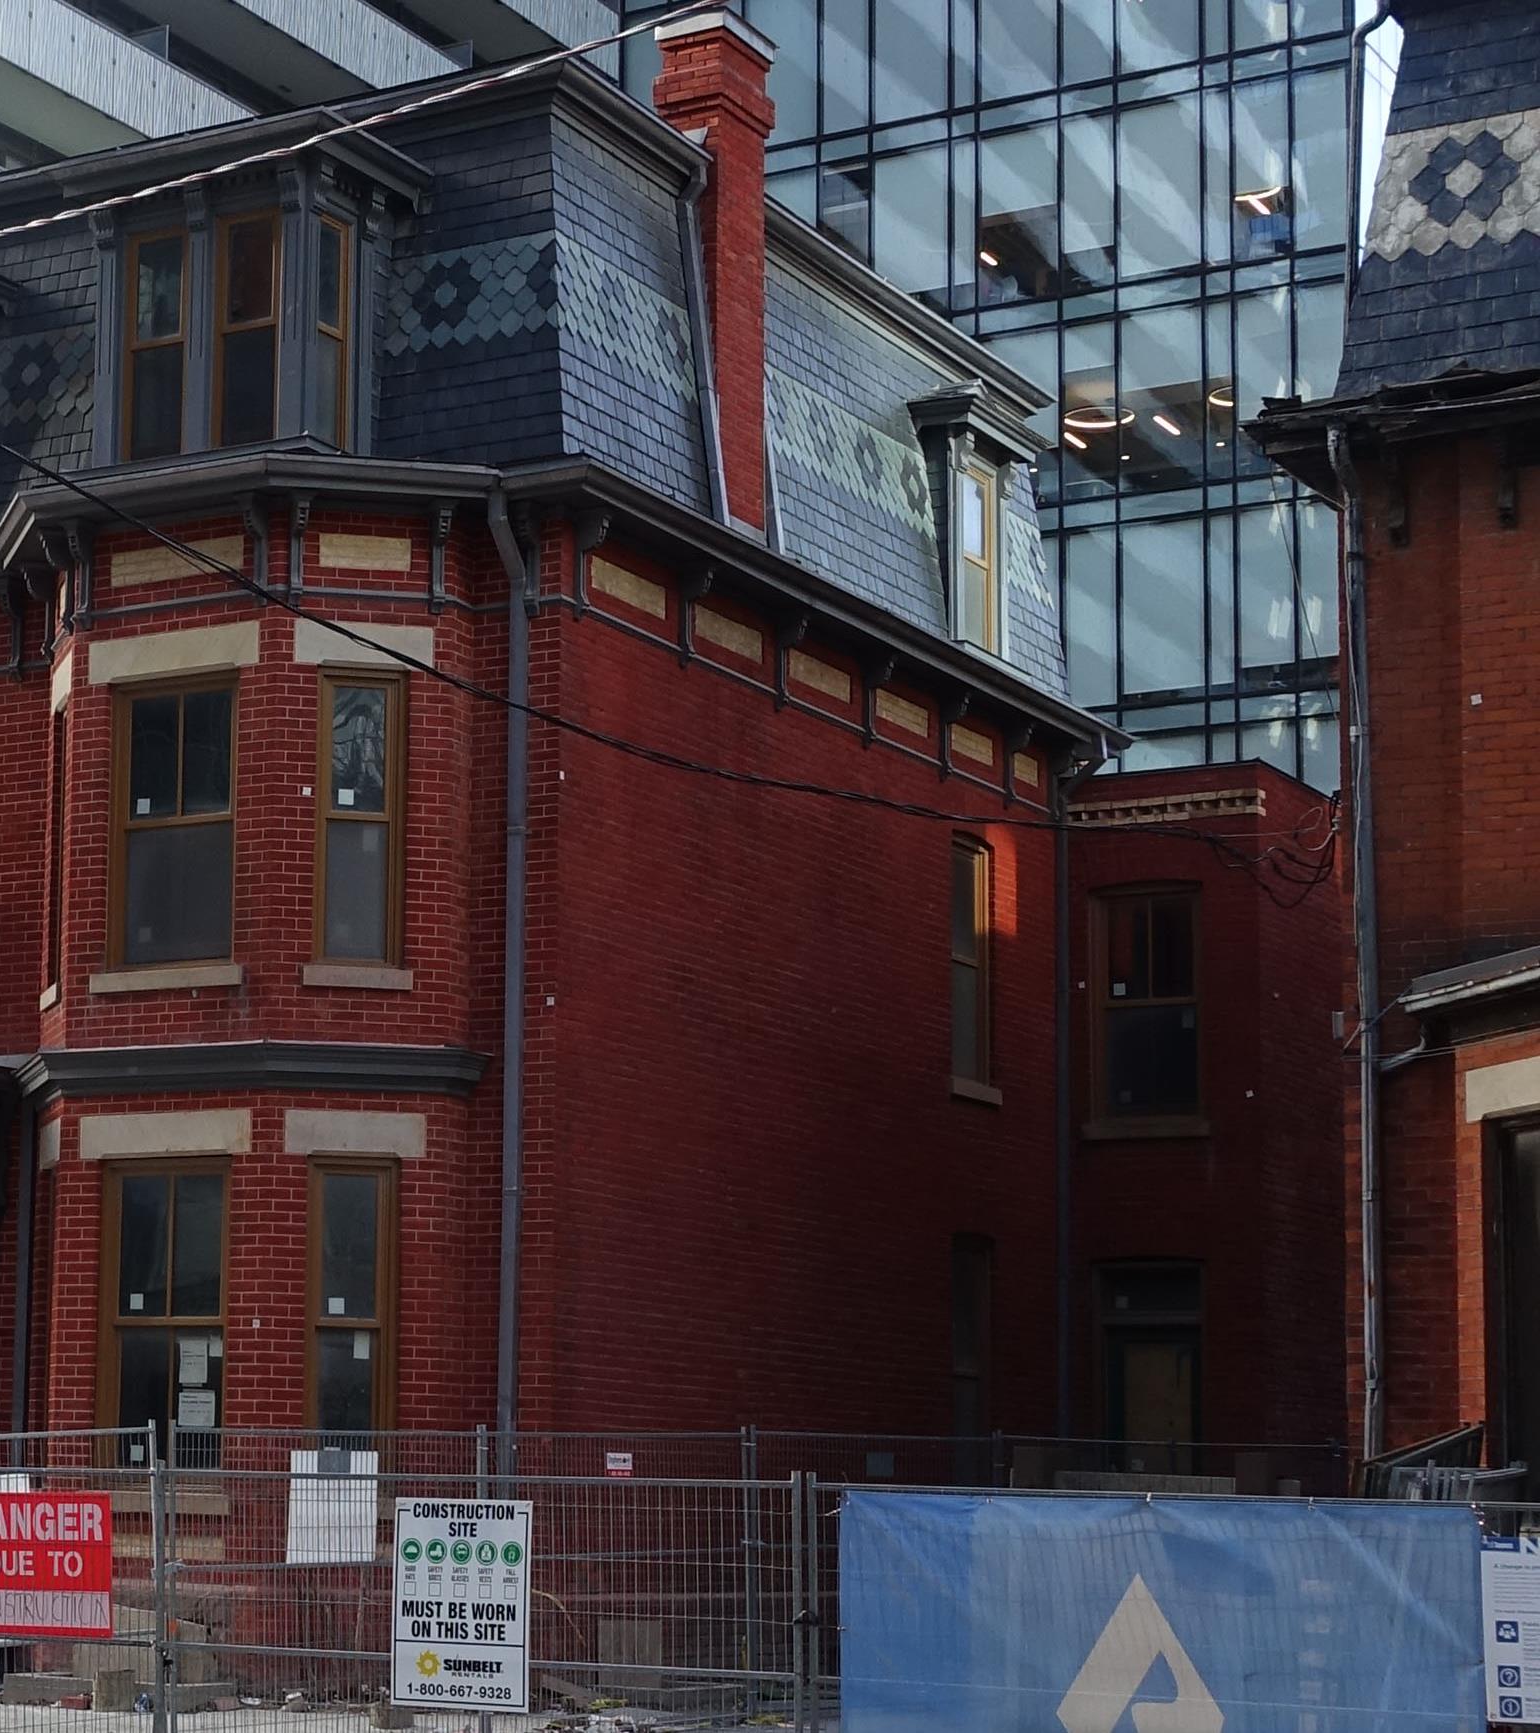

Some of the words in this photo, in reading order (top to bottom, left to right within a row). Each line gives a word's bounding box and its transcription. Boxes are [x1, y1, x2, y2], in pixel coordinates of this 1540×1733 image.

[413, 1503, 515, 1520] CONSTRUCTION
[448, 1522, 477, 1538] SITE
[48, 1551, 83, 1577] TO
[402, 1600, 443, 1618] MUST
[448, 1602, 467, 1619] BE
[472, 1603, 516, 1621] WORN
[411, 1620, 431, 1637] ON
[436, 1621, 468, 1639] THIS
[474, 1623, 506, 1641] SITE
[443, 1659, 502, 1674] SUNBELT
[407, 1682, 512, 1699] 1-800-667-9328
